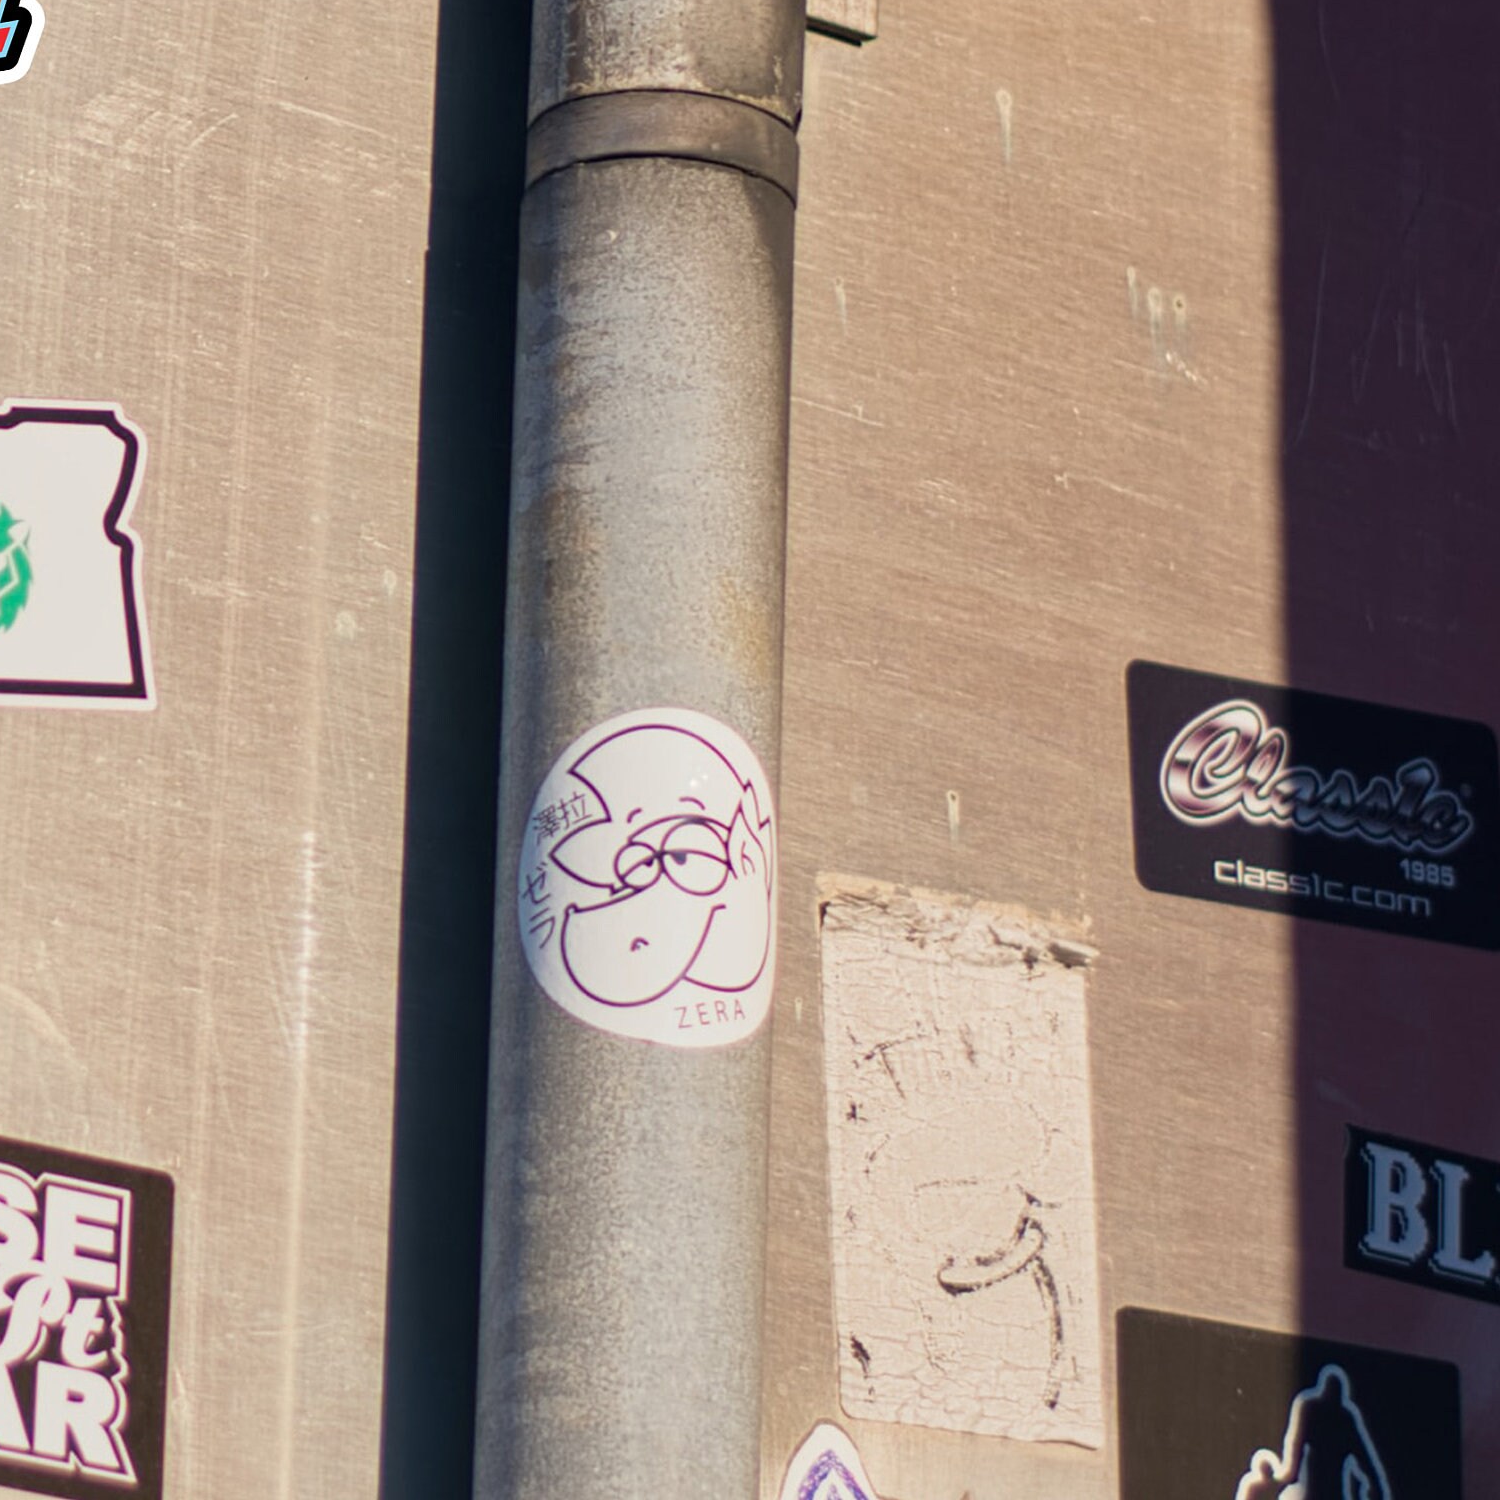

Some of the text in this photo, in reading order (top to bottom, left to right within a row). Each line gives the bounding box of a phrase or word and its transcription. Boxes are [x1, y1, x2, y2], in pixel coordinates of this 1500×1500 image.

[1160, 699, 1473, 853] Classic
[521, 861, 556, 949] ゼラ
[1213, 859, 1431, 917] classic.com
[1399, 858, 1456, 888] 1985
[674, 998, 747, 1029] ZERA
[1358, 1141, 1500, 1288] BL
